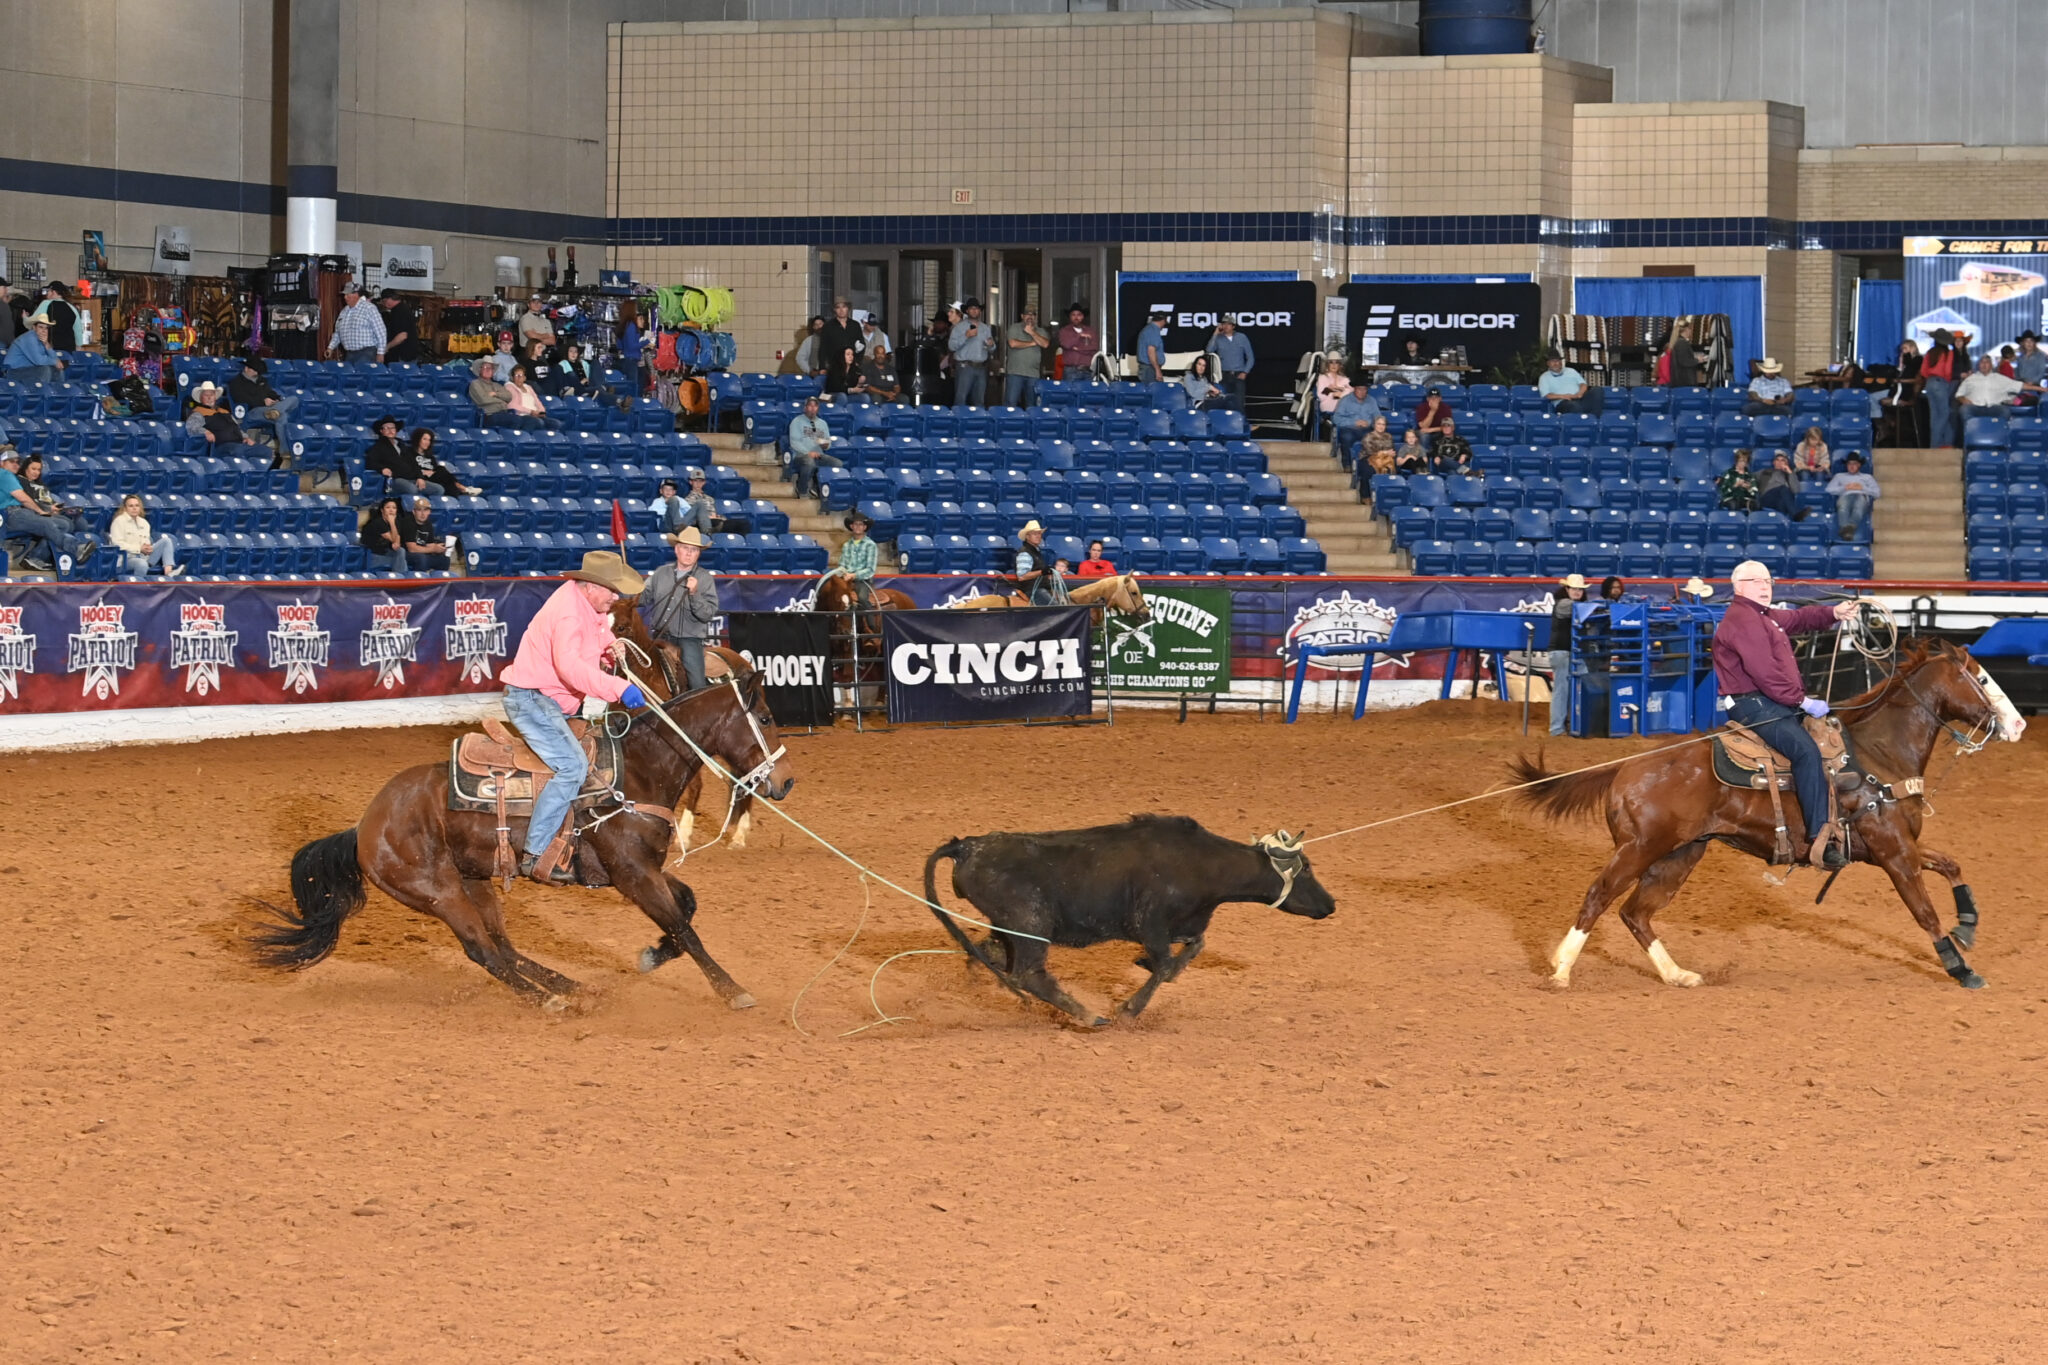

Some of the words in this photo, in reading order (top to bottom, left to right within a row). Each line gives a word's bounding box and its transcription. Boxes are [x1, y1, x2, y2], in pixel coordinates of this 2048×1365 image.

[955, 190, 970, 202] EXIT
[1949, 240, 2001, 252] CHOICE
[2003, 240, 2033, 252] FOR
[1398, 313, 1515, 330] EQUICOR
[82, 607, 122, 622] HOOEY
[182, 606, 223, 620] HOOEY
[278, 606, 318, 621] HOOEY
[374, 605, 410, 619] HOOEY
[455, 600, 494, 615] HOOEY
[0, 608, 21, 623] OEY
[268, 632, 329, 666] PATRIOT
[361, 628, 421, 664] PATRIOT
[446, 624, 507, 659] PATRIOT
[0, 637, 35, 671] RIOT
[69, 634, 137, 671] PATRIOT
[171, 632, 237, 667] PATRIOT
[891, 638, 1083, 685] CINCH
[1159, 662, 1220, 671] 940-626-8387
[757, 655, 826, 687] HOOEY
[1127, 675, 1190, 687] CHAMPIONS
[981, 682, 1085, 696] CINCHJEANS.COM
